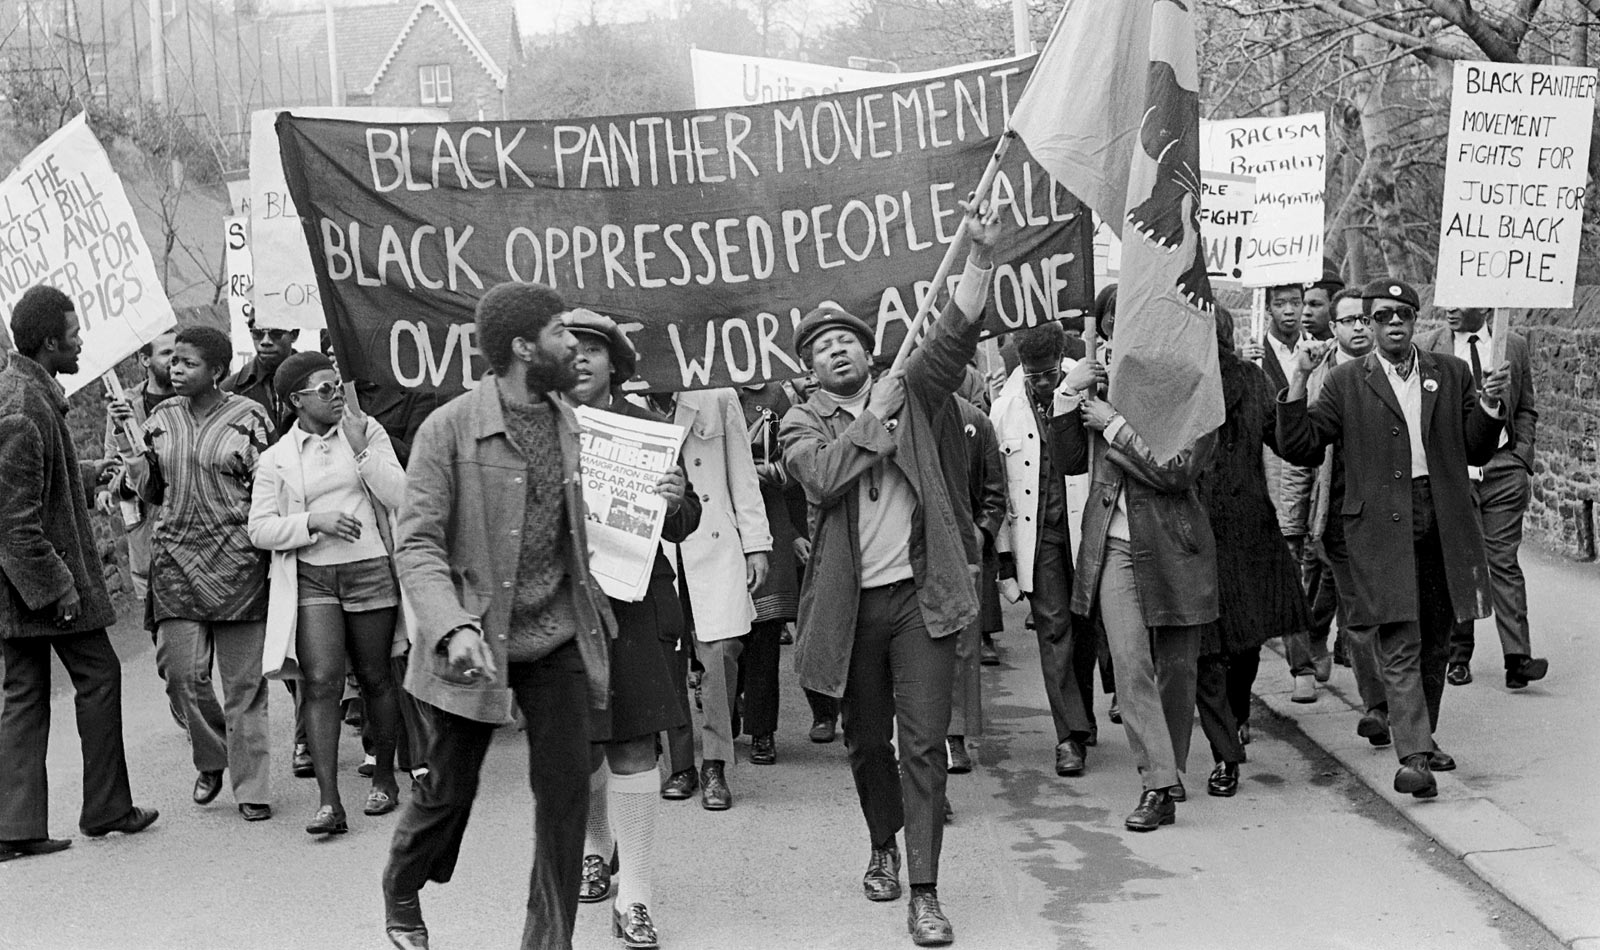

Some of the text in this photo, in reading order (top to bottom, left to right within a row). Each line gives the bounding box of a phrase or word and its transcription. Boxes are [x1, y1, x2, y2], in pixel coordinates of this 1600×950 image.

[1466, 67, 1597, 99] BLACK PANTHER
[365, 68, 1019, 193] BLACK PANTHER MOVEMENT
[1225, 124, 1320, 149] RACISM
[1462, 110, 1557, 137] MOVEMENT
[1458, 143, 1574, 170] FIGHTS FOR
[21, 153, 67, 206] THE
[1201, 183, 1229, 196] PLE
[1459, 181, 1586, 211] JUSTICE FOR
[0, 171, 103, 268] ACIST BILL
[321, 161, 1079, 290] BLACK OPPRESSED PEOPLE ALL
[1199, 209, 1253, 226] FIGHT
[1446, 212, 1564, 243] ALL BLACK
[0, 200, 111, 301] NOW AND
[88, 221, 139, 281] FOR
[1459, 250, 1564, 285] PEOPLE.
[78, 260, 143, 332] PIGS
[390, 320, 478, 391] OVE
[993, 253, 1083, 329] ONE
[580, 455, 641, 478] MMIGRATION
[581, 465, 658, 496] DECLARATIO
[588, 479, 638, 503] OF WAR
